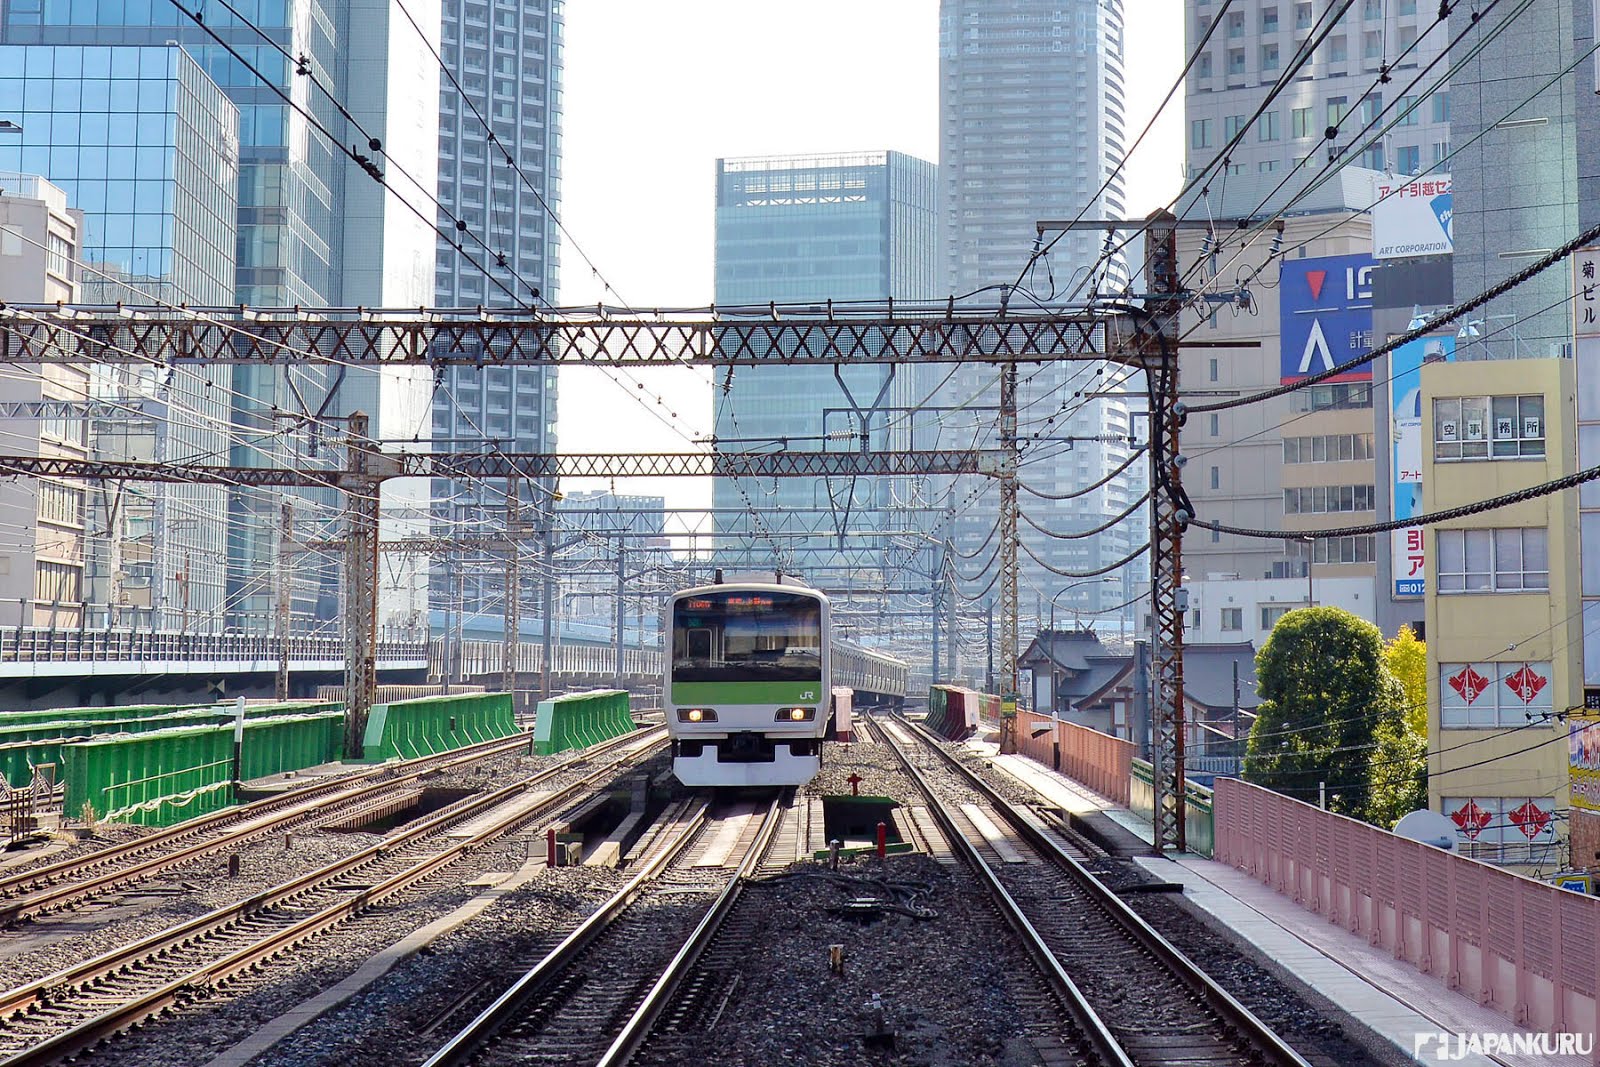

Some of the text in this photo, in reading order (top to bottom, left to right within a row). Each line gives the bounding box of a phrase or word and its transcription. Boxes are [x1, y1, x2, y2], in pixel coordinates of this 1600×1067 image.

[1378, 242, 1447, 255] ART CORPORATION
[1581, 261, 1597, 324] 菊ビル
[1400, 470, 1422, 480] アート
[799, 691, 814, 700] JR
